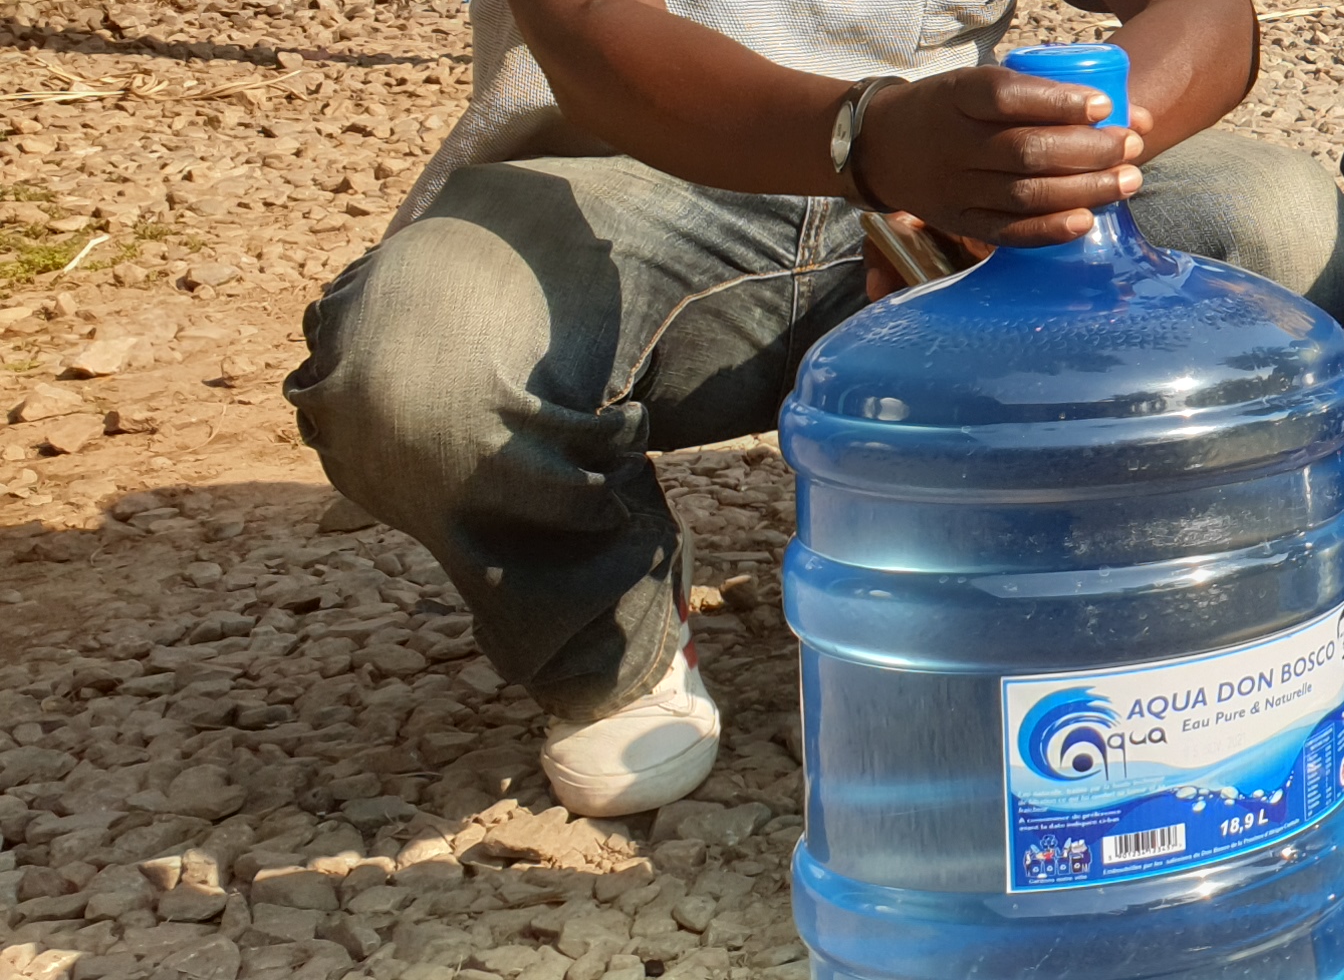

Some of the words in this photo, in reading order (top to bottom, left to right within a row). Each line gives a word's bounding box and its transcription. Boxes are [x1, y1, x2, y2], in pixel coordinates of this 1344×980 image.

[1126, 687, 1208, 721] AQUA
[1216, 668, 1275, 704] DON
[1280, 640, 1336, 684] BOSCO
[1181, 717, 1210, 733] Eau
[1215, 706, 1246, 726] Pure
[1250, 701, 1260, 714] &
[1264, 682, 1313, 712] Naturelle
[1220, 813, 1254, 837] 18,9
[1258, 808, 1269, 825] L
